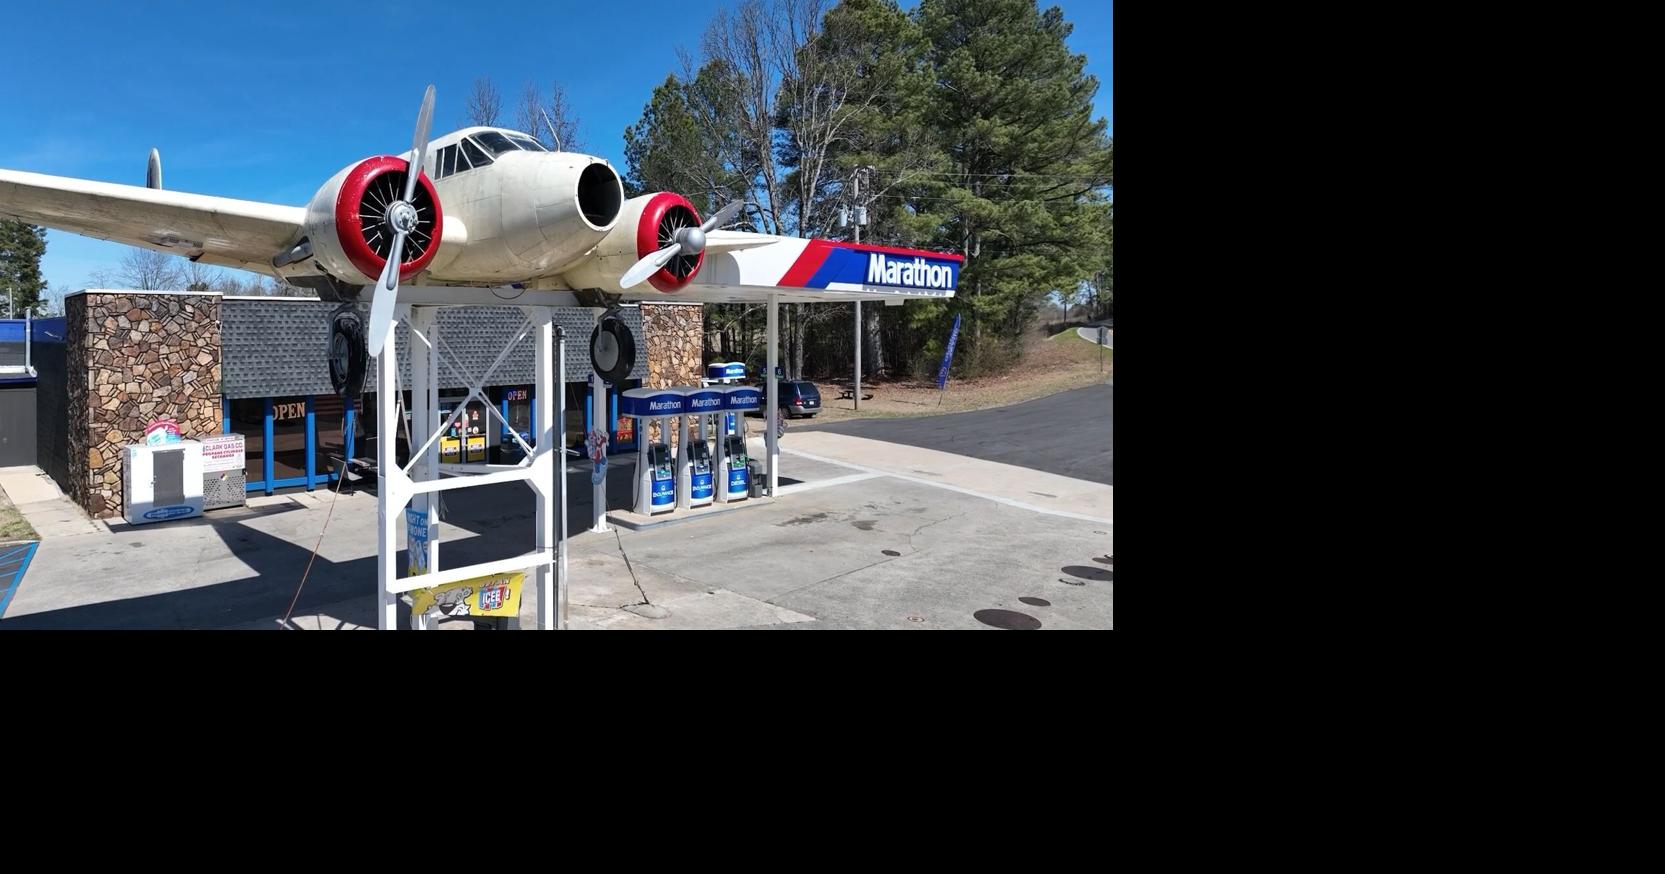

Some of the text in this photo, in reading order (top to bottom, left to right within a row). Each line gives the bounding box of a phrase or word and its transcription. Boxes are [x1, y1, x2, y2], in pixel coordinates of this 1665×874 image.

[868, 252, 953, 288] Marathon
[507, 390, 527, 400] OPEN
[691, 398, 720, 408] Marathon
[731, 396, 758, 405] Marathon
[650, 402, 682, 411] Marathon
[482, 589, 502, 604] ICEE
